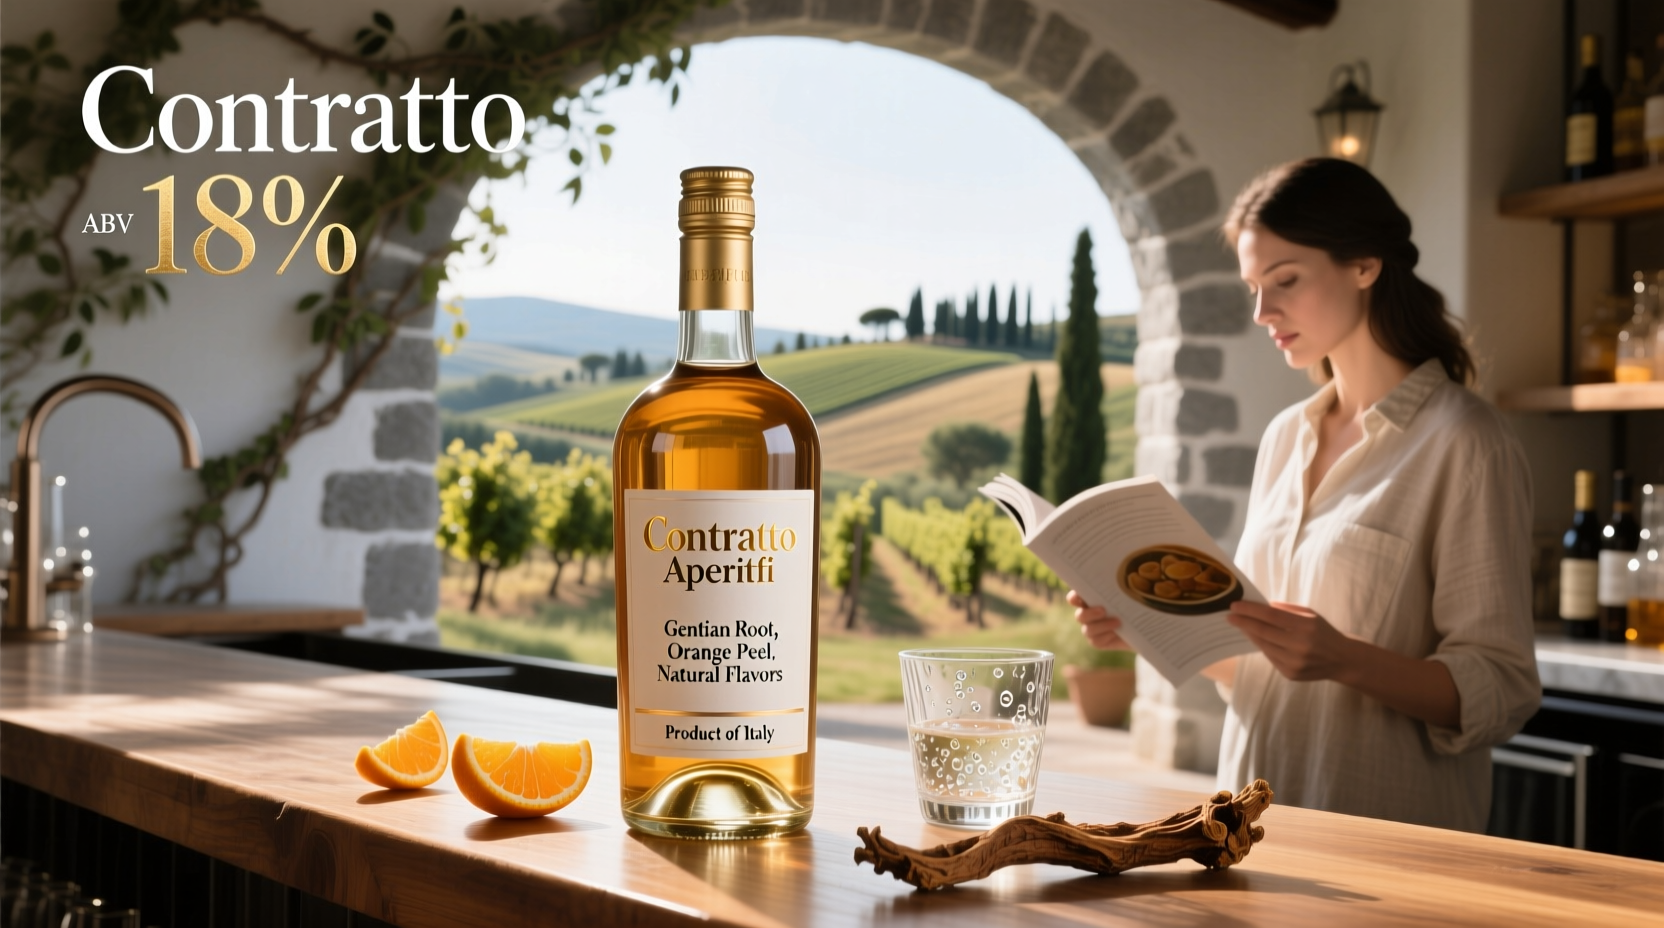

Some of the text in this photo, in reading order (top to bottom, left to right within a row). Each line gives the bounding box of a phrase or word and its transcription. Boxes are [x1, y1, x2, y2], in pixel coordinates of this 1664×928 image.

[643, 515, 797, 551] Contratto
[664, 619, 779, 640] Gentian Root,
[667, 642, 732, 665] Orange
[657, 664, 783, 682] Natural Flavors
[665, 724, 775, 744] Product of Italy
